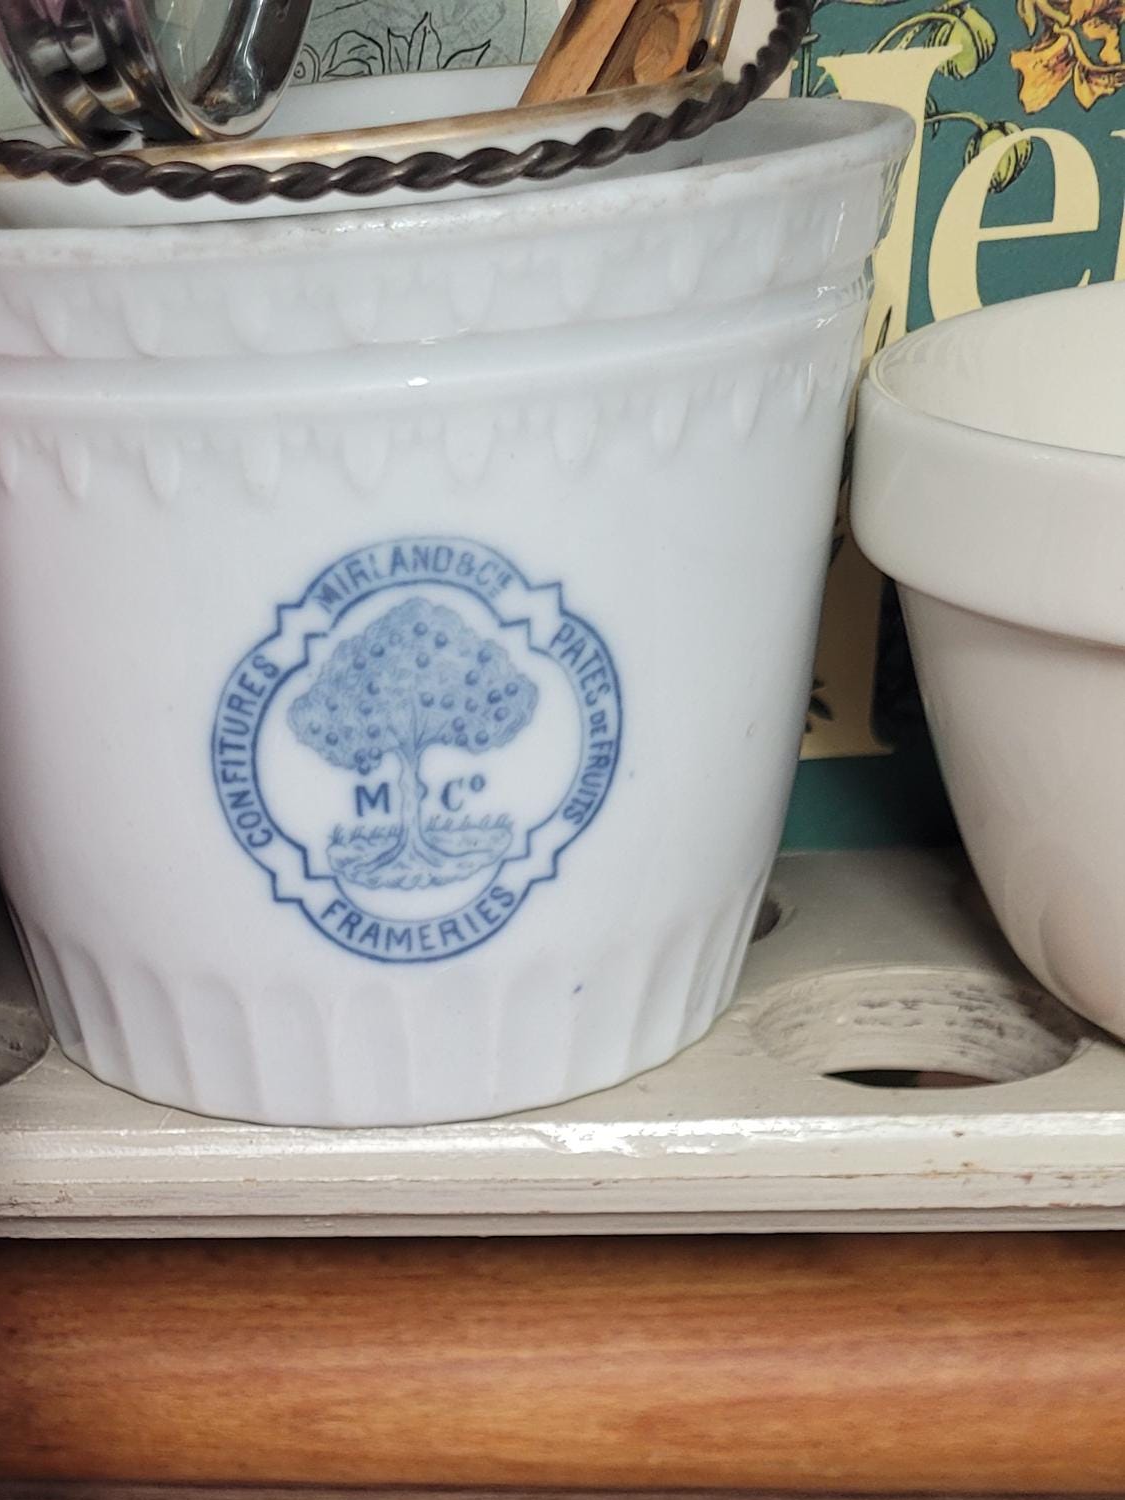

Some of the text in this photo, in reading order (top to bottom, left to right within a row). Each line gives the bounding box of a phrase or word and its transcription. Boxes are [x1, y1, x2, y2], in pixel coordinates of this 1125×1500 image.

[218, 653, 280, 848] CONFITURES
[589, 709, 608, 739] DE
[354, 782, 390, 817] M
[562, 739, 613, 825] FRUITS
[320, 885, 517, 953] FRAMERIES
